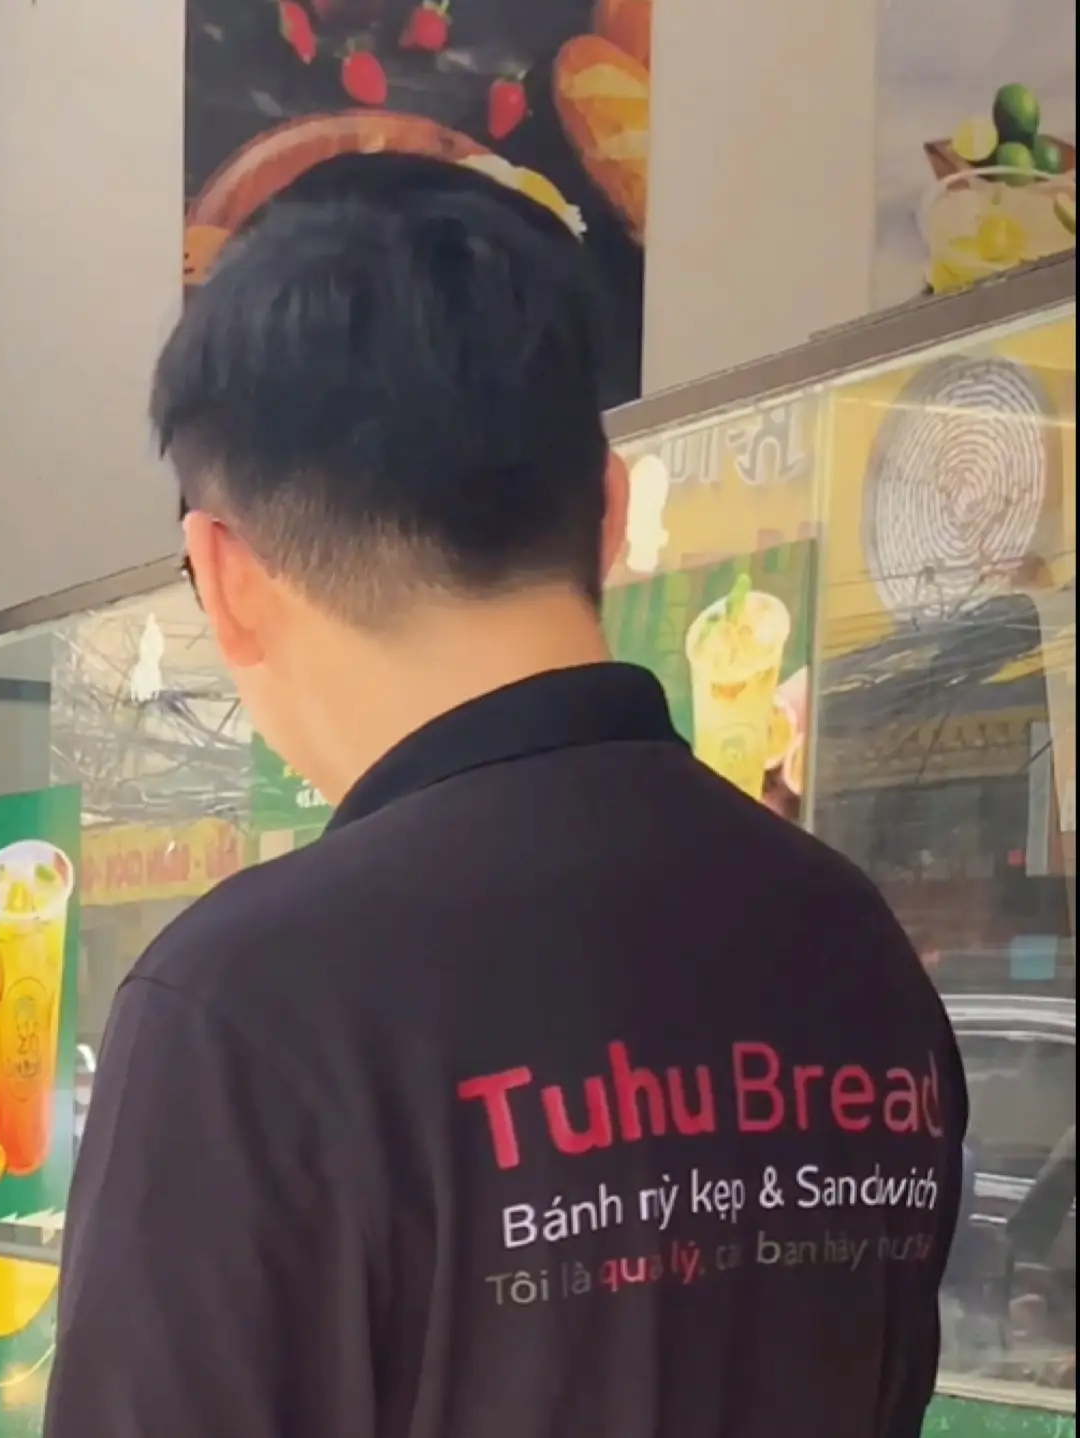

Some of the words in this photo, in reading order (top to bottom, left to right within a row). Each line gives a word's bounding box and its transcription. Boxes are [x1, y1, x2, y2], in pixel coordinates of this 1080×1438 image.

[457, 1040, 716, 1170] Tuhu
[732, 1040, 944, 1138] Bread
[502, 1182, 624, 1249] Bánh
[691, 1167, 746, 1224] kẹp
[758, 1165, 785, 1209] &
[795, 1162, 938, 1211] Sandwich
[485, 1270, 550, 1306] Tôi
[561, 1260, 592, 1297] là
